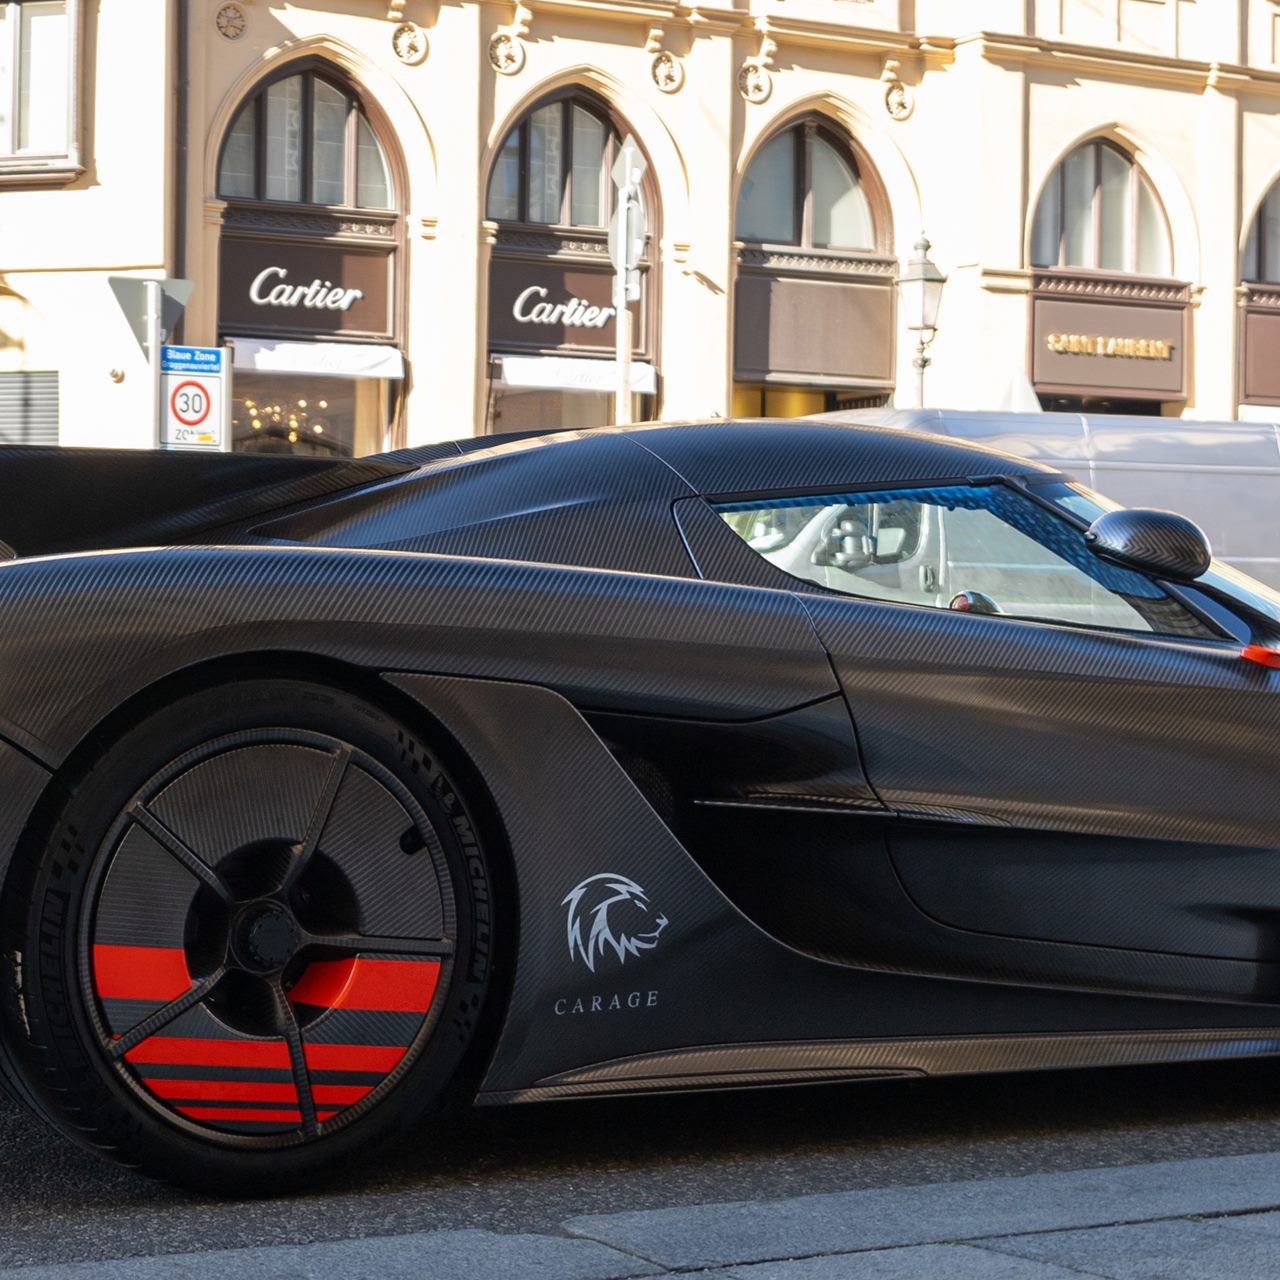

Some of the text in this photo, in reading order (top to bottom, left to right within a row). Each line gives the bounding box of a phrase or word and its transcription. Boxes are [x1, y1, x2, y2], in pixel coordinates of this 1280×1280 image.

[249, 266, 363, 310] Cartier
[512, 285, 616, 328] Cartier
[166, 349, 216, 362] Blaue Zone
[179, 392, 203, 414] 30
[450, 815, 490, 983] MICHELIN
[554, 990, 659, 1016] CARAGE
